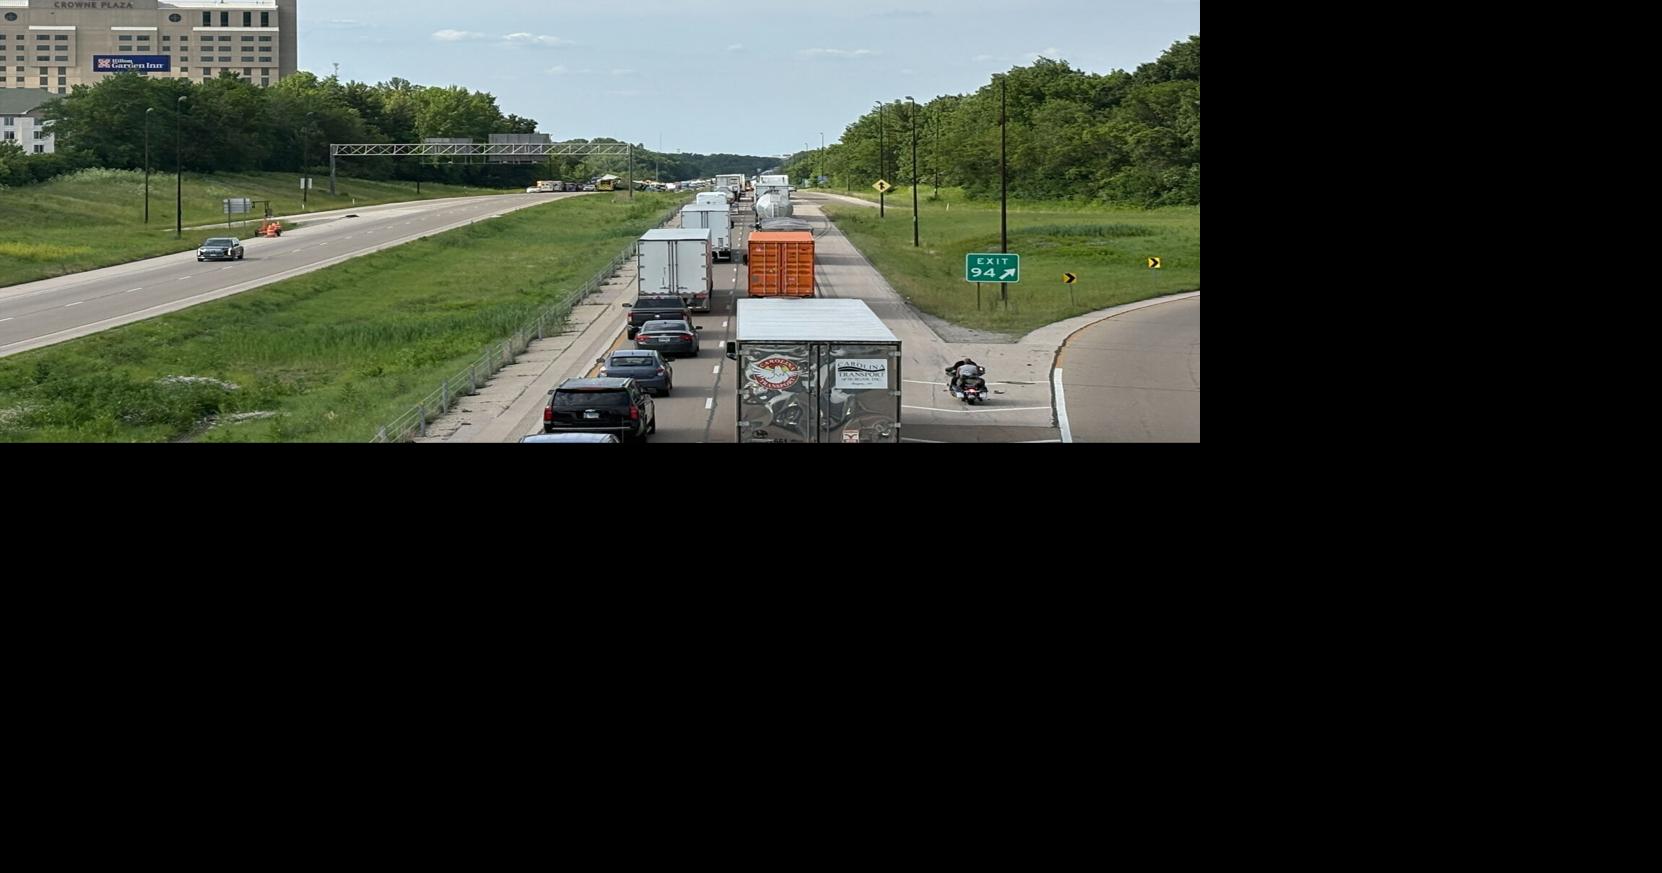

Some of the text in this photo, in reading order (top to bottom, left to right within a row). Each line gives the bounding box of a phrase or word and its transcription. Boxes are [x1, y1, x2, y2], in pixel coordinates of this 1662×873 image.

[54, 1, 133, 9] CROWNE PLAZA
[977, 257, 1008, 265] EXIT
[970, 267, 996, 278] 94
[837, 361, 885, 370] CAROLINA
